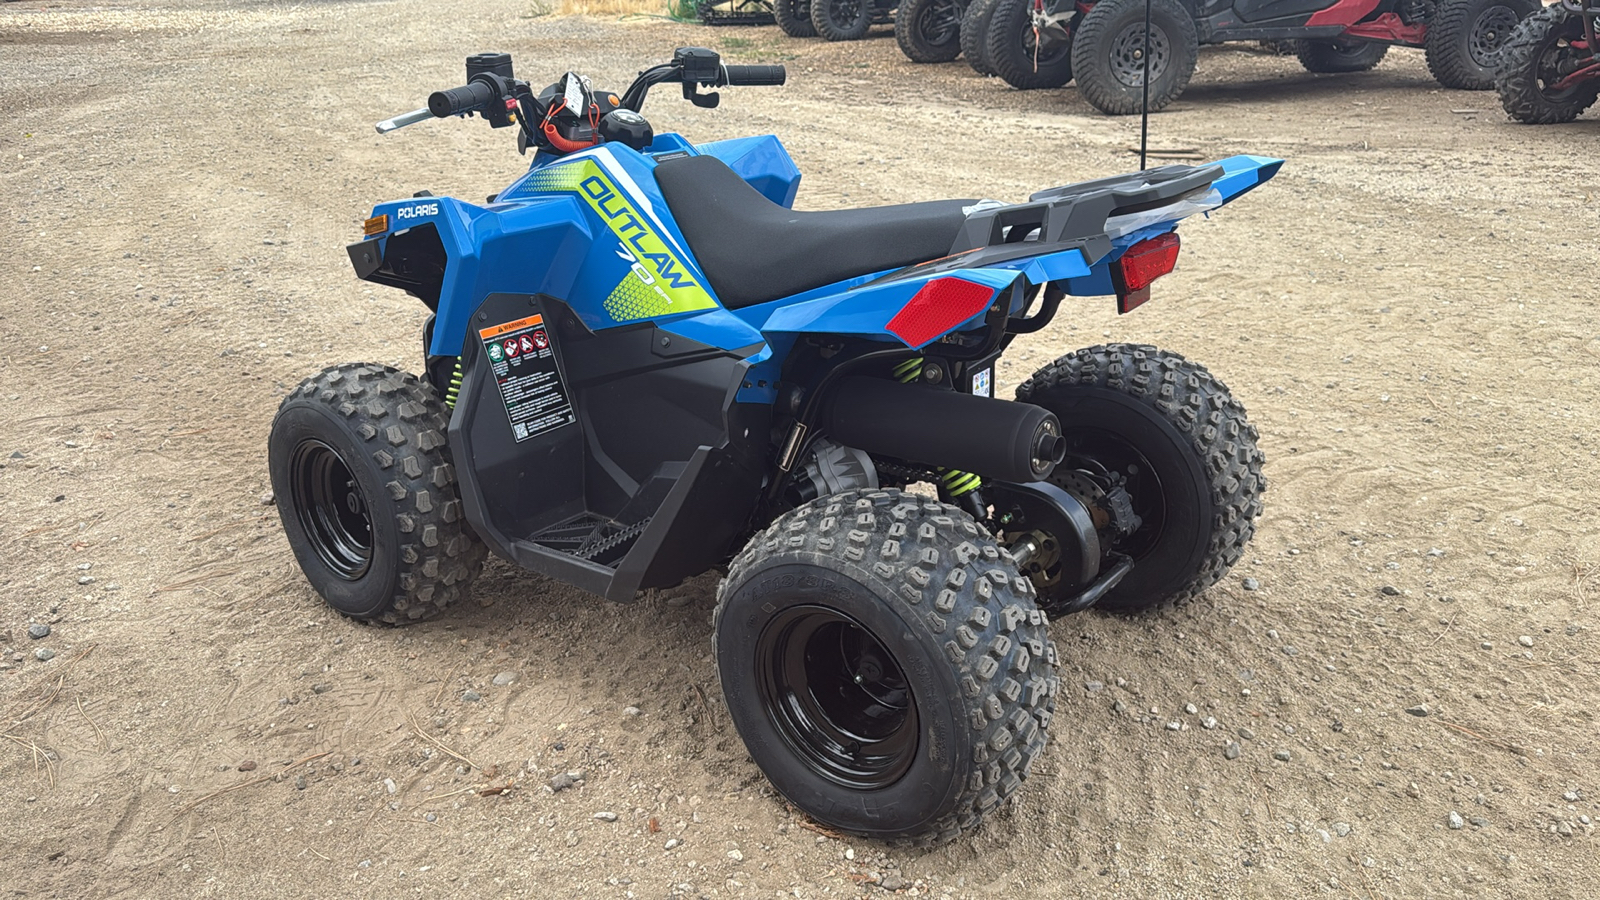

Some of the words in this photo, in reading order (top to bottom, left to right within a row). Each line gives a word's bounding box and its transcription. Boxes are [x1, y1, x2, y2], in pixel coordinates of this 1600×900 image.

[397, 203, 439, 220] POLARIS
[580, 175, 697, 289] OUTLAW
[615, 241, 656, 286] 70
[503, 319, 527, 331] WARNING
